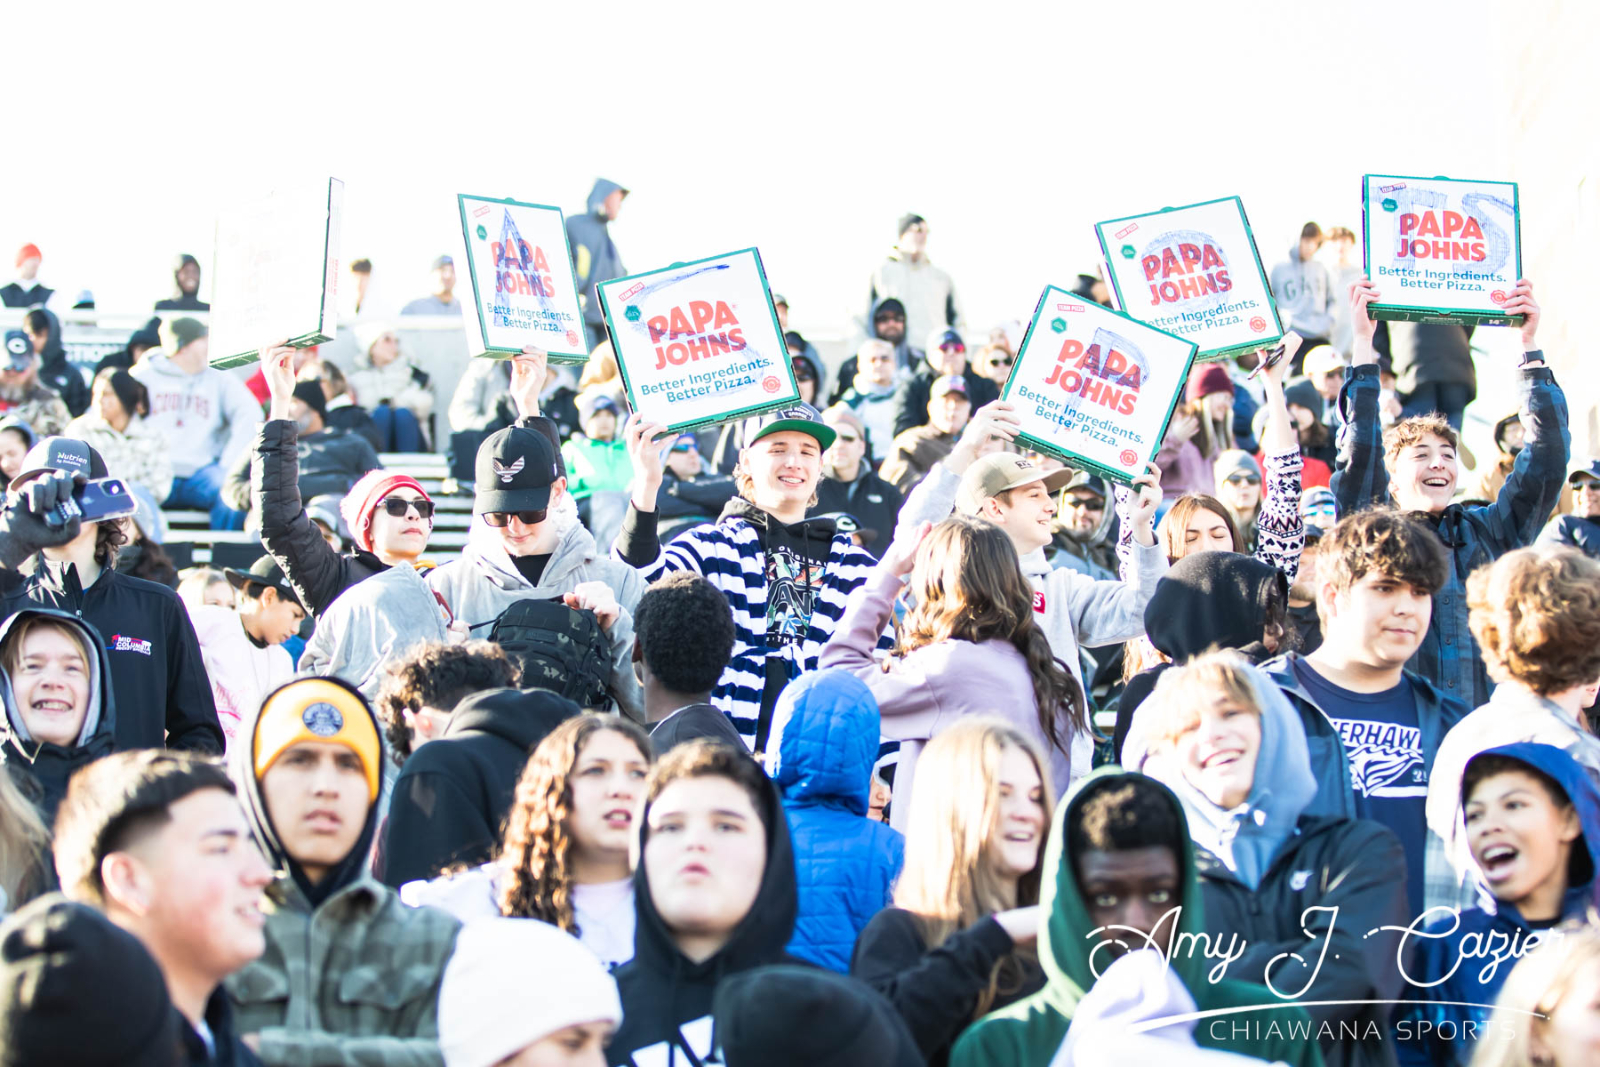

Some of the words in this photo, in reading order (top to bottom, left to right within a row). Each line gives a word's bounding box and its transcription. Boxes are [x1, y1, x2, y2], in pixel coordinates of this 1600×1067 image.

[1400, 210, 1484, 240] PAPA
[491, 238, 551, 273] PAPA
[1142, 243, 1225, 281] PAPA
[1397, 238, 1486, 262] JOHNS
[495, 270, 555, 298] JOHNS
[1150, 270, 1233, 306] JOHNS
[1379, 266, 1421, 278] Better
[1425, 269, 1507, 283] Ingredients.
[1400, 278, 1443, 290] Better
[1447, 280, 1486, 292] Pizza.
[487, 302, 515, 317] Better
[517, 305, 574, 322] Ingredients.
[503, 316, 532, 330] Better
[534, 320, 562, 333] Pizza.
[647, 300, 739, 345] PAPA
[1181, 299, 1260, 322] Ingredients.
[1205, 315, 1244, 330] Pizza.
[655, 328, 747, 371] JOHNS
[641, 376, 686, 396] Better
[689, 358, 774, 387] Ingredients.
[1057, 339, 1141, 394] PAPA
[667, 383, 711, 403] Better
[715, 374, 756, 392] Pizza.
[1045, 364, 1137, 416] JOHNS
[1018, 386, 1062, 411] Better
[1063, 404, 1144, 445] Ingredients.
[1035, 405, 1079, 430] Better
[1081, 424, 1118, 448] Pizza.
[57, 451, 88, 465] Nutrien
[777, 635, 798, 644] THE
